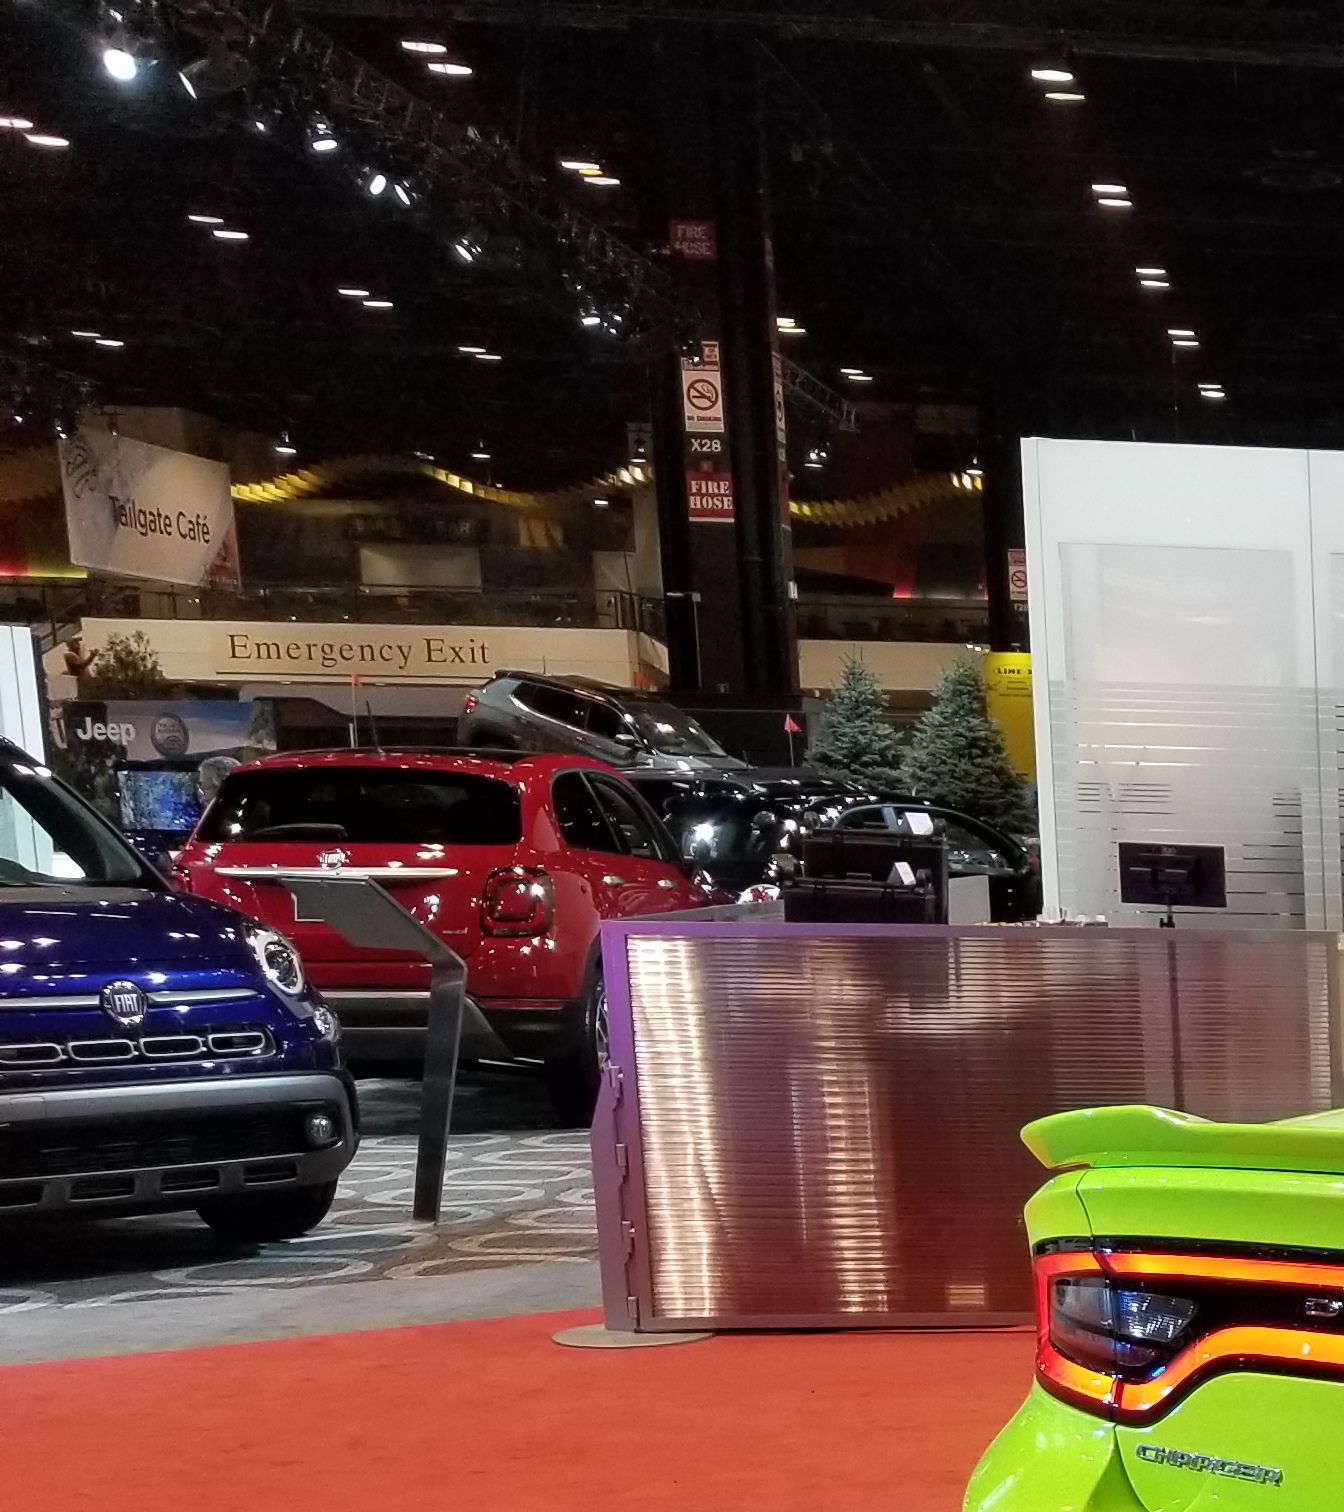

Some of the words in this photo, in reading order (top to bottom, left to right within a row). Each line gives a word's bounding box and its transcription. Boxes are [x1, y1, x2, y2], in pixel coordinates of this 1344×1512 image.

[691, 438, 721, 453] X28
[690, 480, 729, 494] FIRE
[689, 496, 733, 510] HOSE
[108, 495, 172, 537] Tailgate
[177, 511, 211, 544] Café
[226, 633, 412, 669] Emergency
[423, 637, 490, 664] Exit
[76, 716, 137, 746] Jeep
[113, 993, 139, 1012] FIAT
[1136, 1444, 1283, 1487] CHARGER
